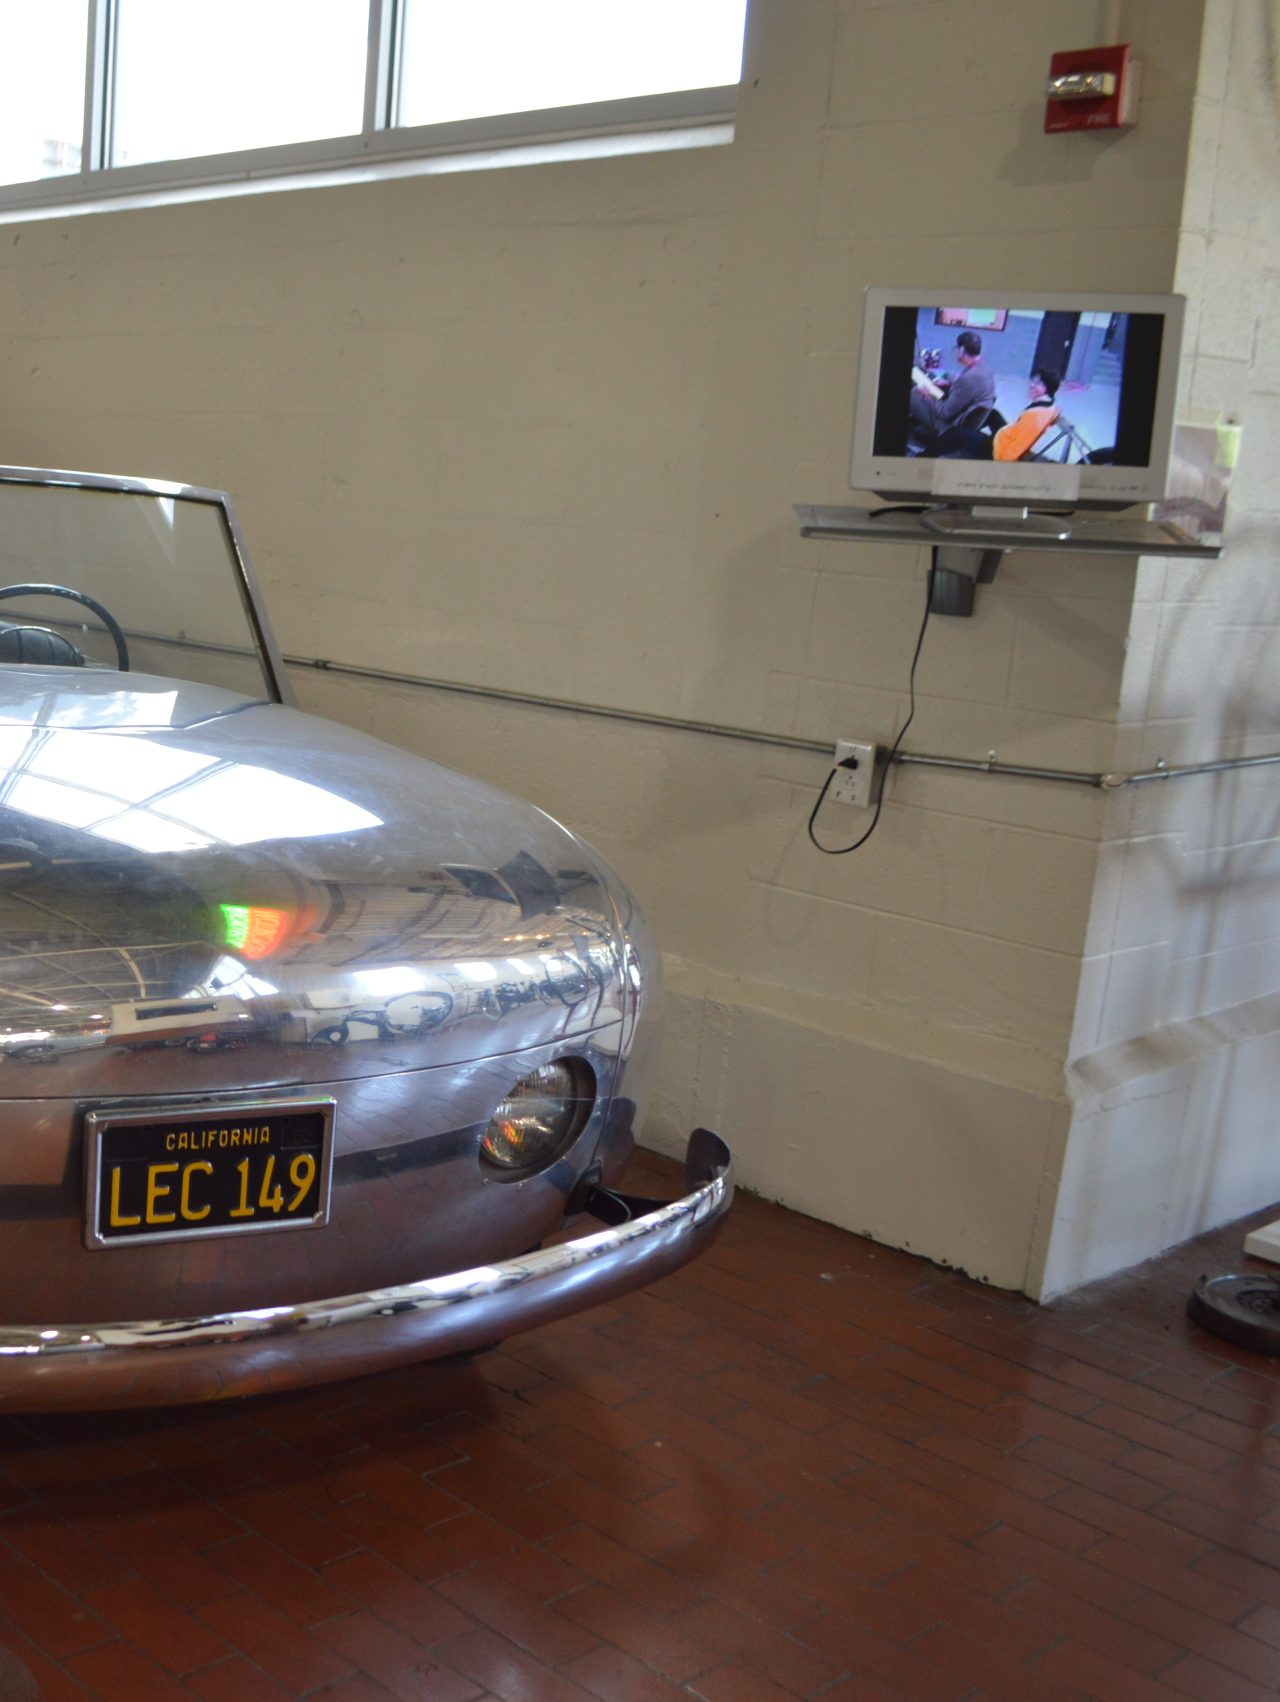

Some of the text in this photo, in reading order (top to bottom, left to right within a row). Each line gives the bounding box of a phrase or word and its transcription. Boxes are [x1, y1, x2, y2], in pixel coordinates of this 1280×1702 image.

[165, 1126, 270, 1151] CALIFORNIA
[109, 1153, 316, 1227] LEC 149
